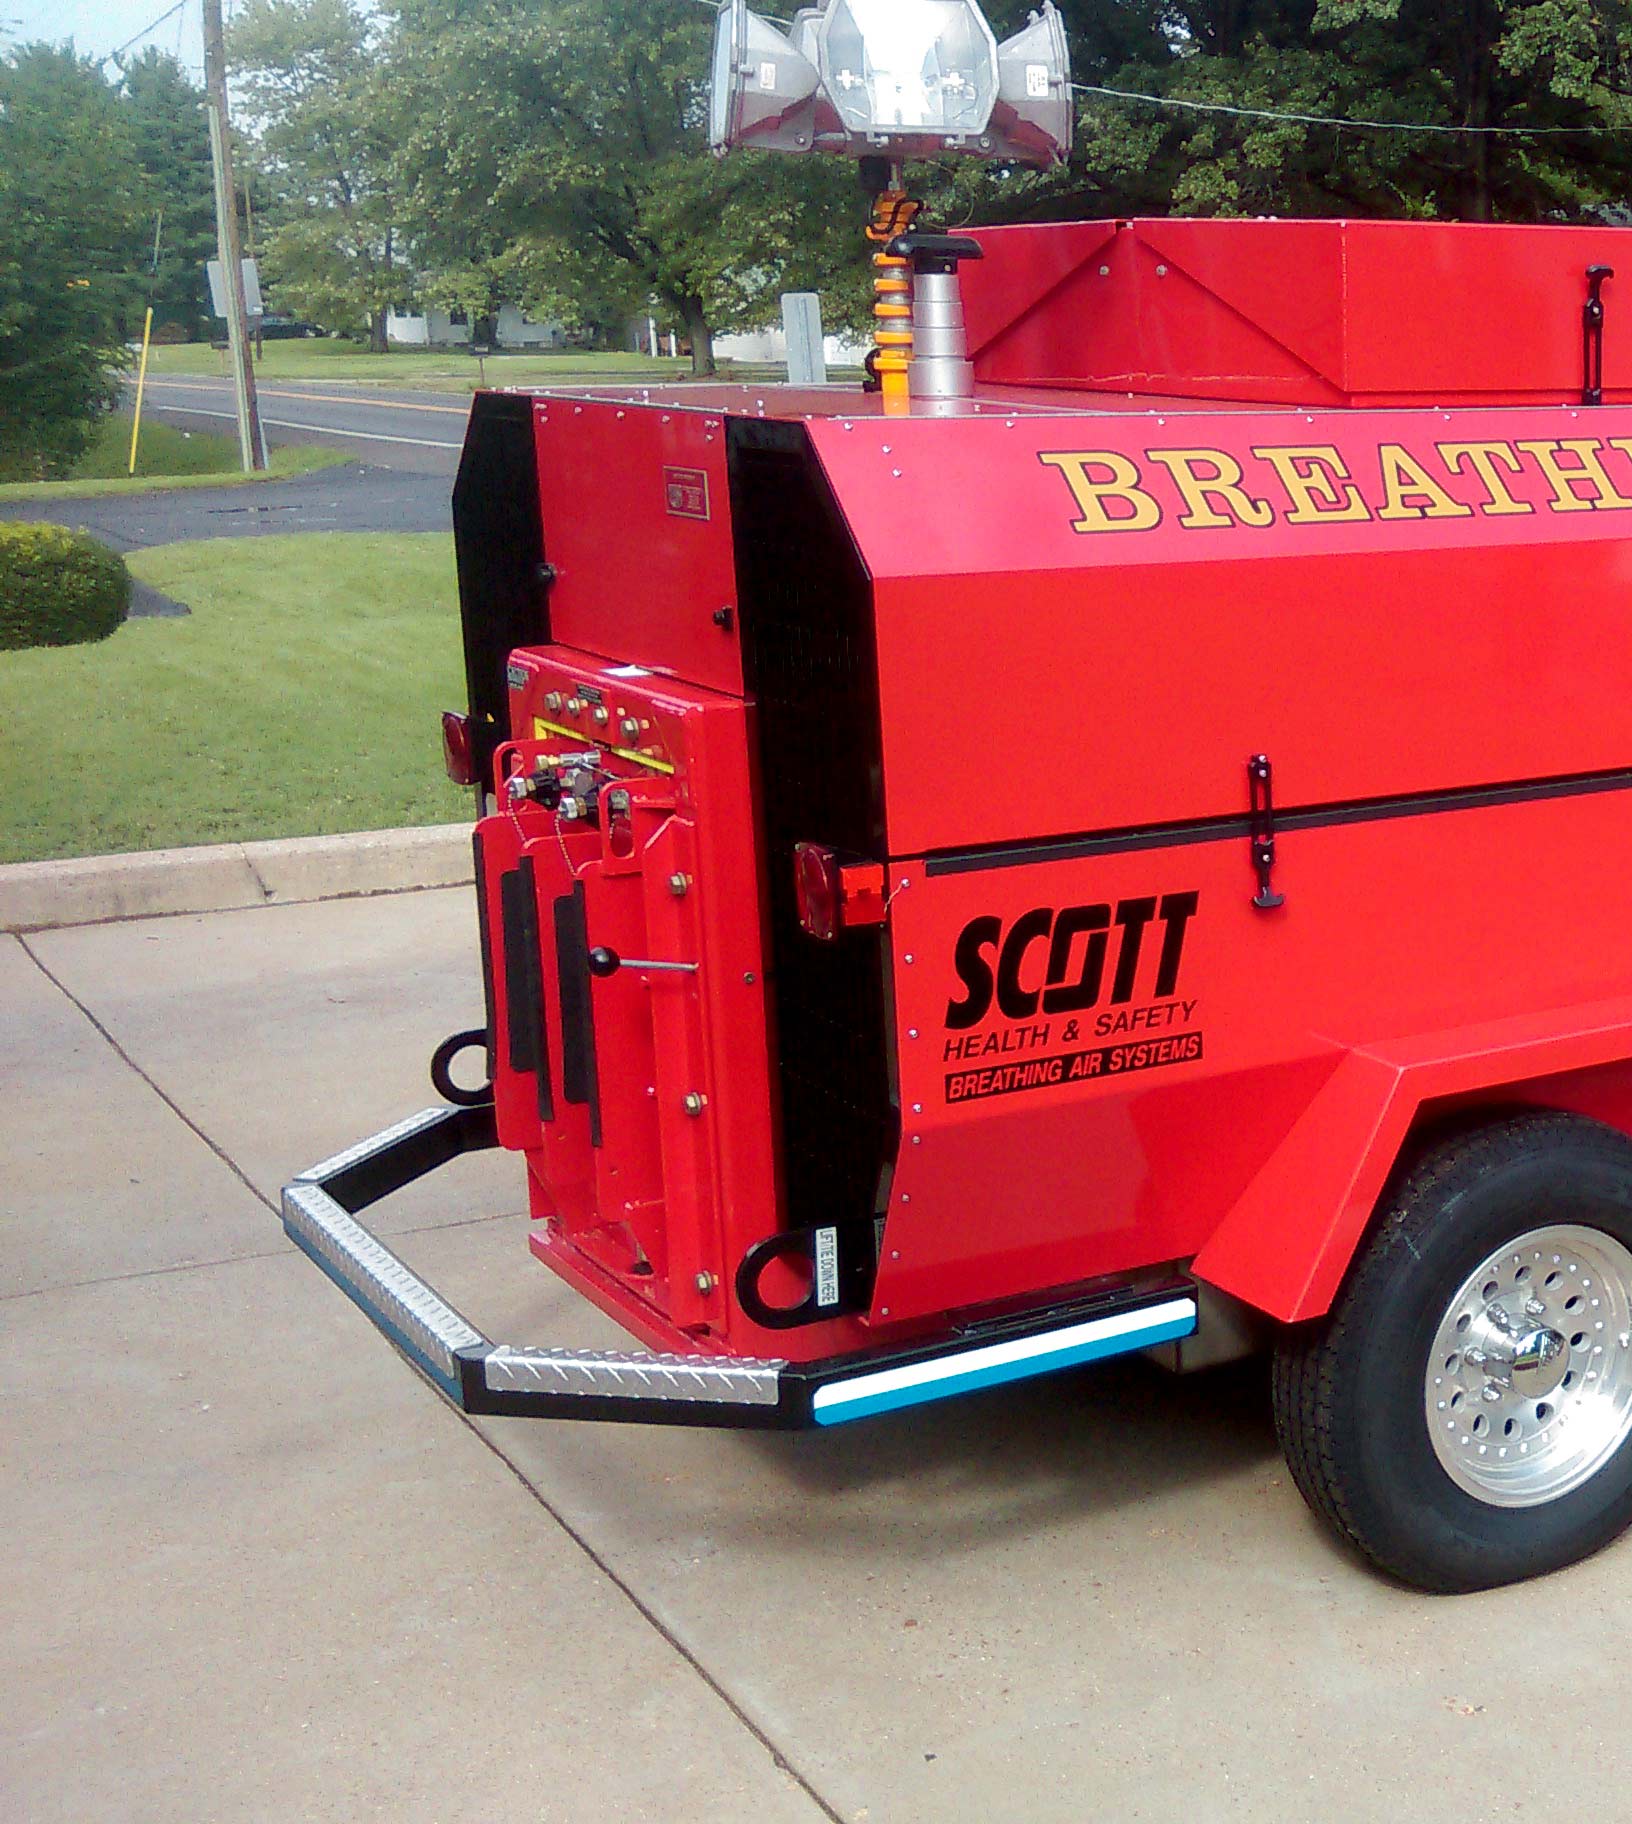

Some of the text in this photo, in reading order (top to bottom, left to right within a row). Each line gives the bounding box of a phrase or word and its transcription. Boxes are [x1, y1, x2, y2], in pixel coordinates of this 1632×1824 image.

[944, 890, 1199, 1030] SCOTT
[943, 999, 1198, 1062] HEALTH & SAFETY
[949, 1035, 1200, 1099] BREATHING AIR SYSTEMS
